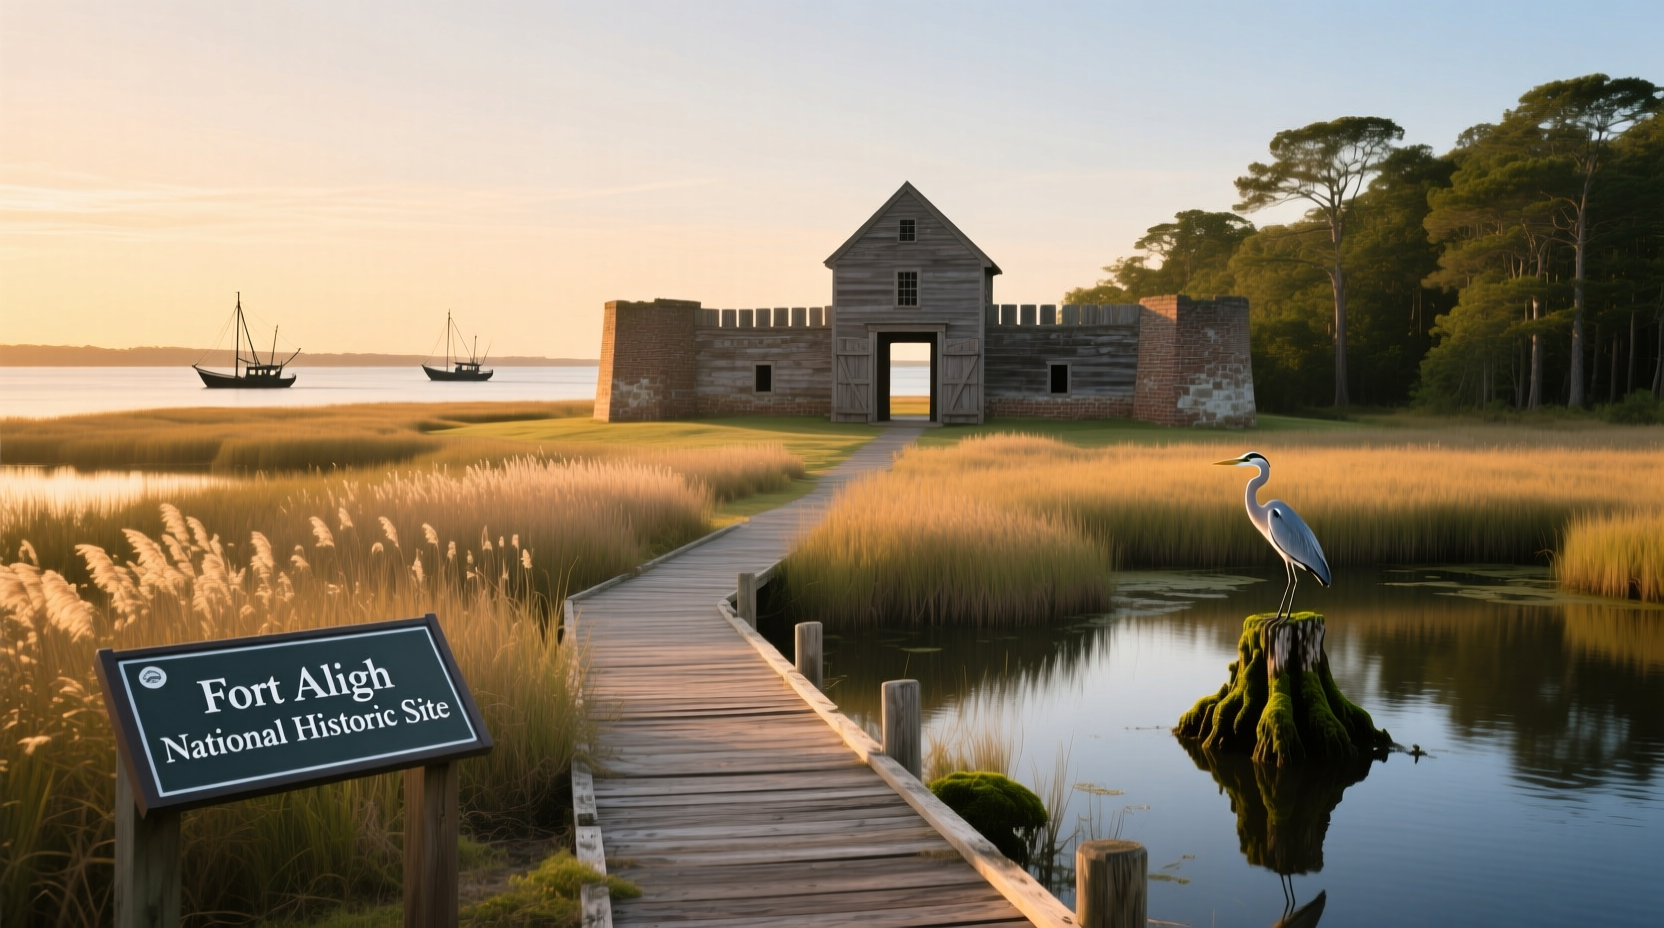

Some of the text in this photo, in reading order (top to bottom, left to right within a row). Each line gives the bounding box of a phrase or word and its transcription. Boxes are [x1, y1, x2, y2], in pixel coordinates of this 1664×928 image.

[197, 658, 396, 714] Fort Aligh
[160, 697, 451, 764] National Historic Site
